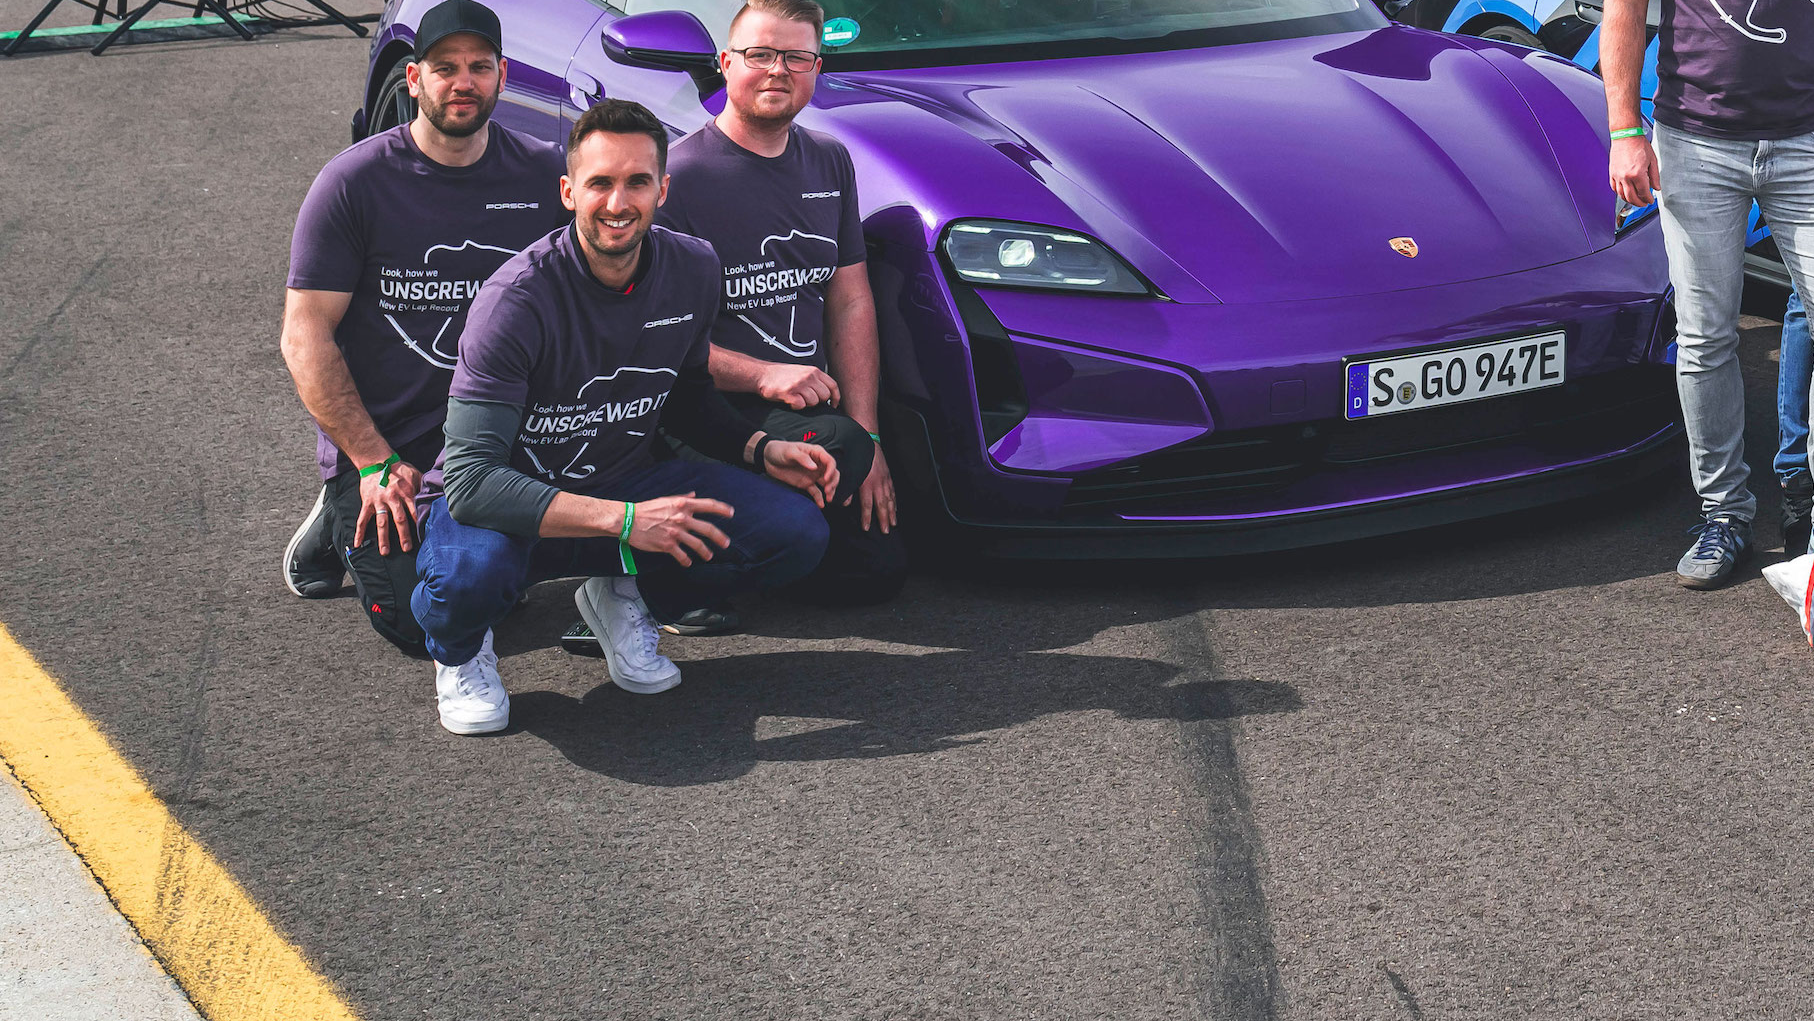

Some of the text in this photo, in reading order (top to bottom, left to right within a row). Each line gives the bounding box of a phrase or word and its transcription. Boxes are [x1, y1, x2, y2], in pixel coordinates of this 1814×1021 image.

[485, 202, 539, 210] PORSCHE
[381, 266, 438, 279] Look, how we
[724, 260, 775, 275] Look, how we
[380, 279, 486, 300] UNSCREW
[378, 299, 460, 312] New EV Lap Record
[727, 292, 797, 310] New EV Lap Record
[643, 313, 694, 330] ORSCHE
[1372, 340, 1560, 407] S GO 947E
[556, 404, 575, 413] how
[576, 403, 588, 411] we
[1353, 396, 1362, 409] D
[525, 390, 671, 433] UNSCREWED IT
[518, 433, 539, 445] New
[540, 436, 552, 445] EV
